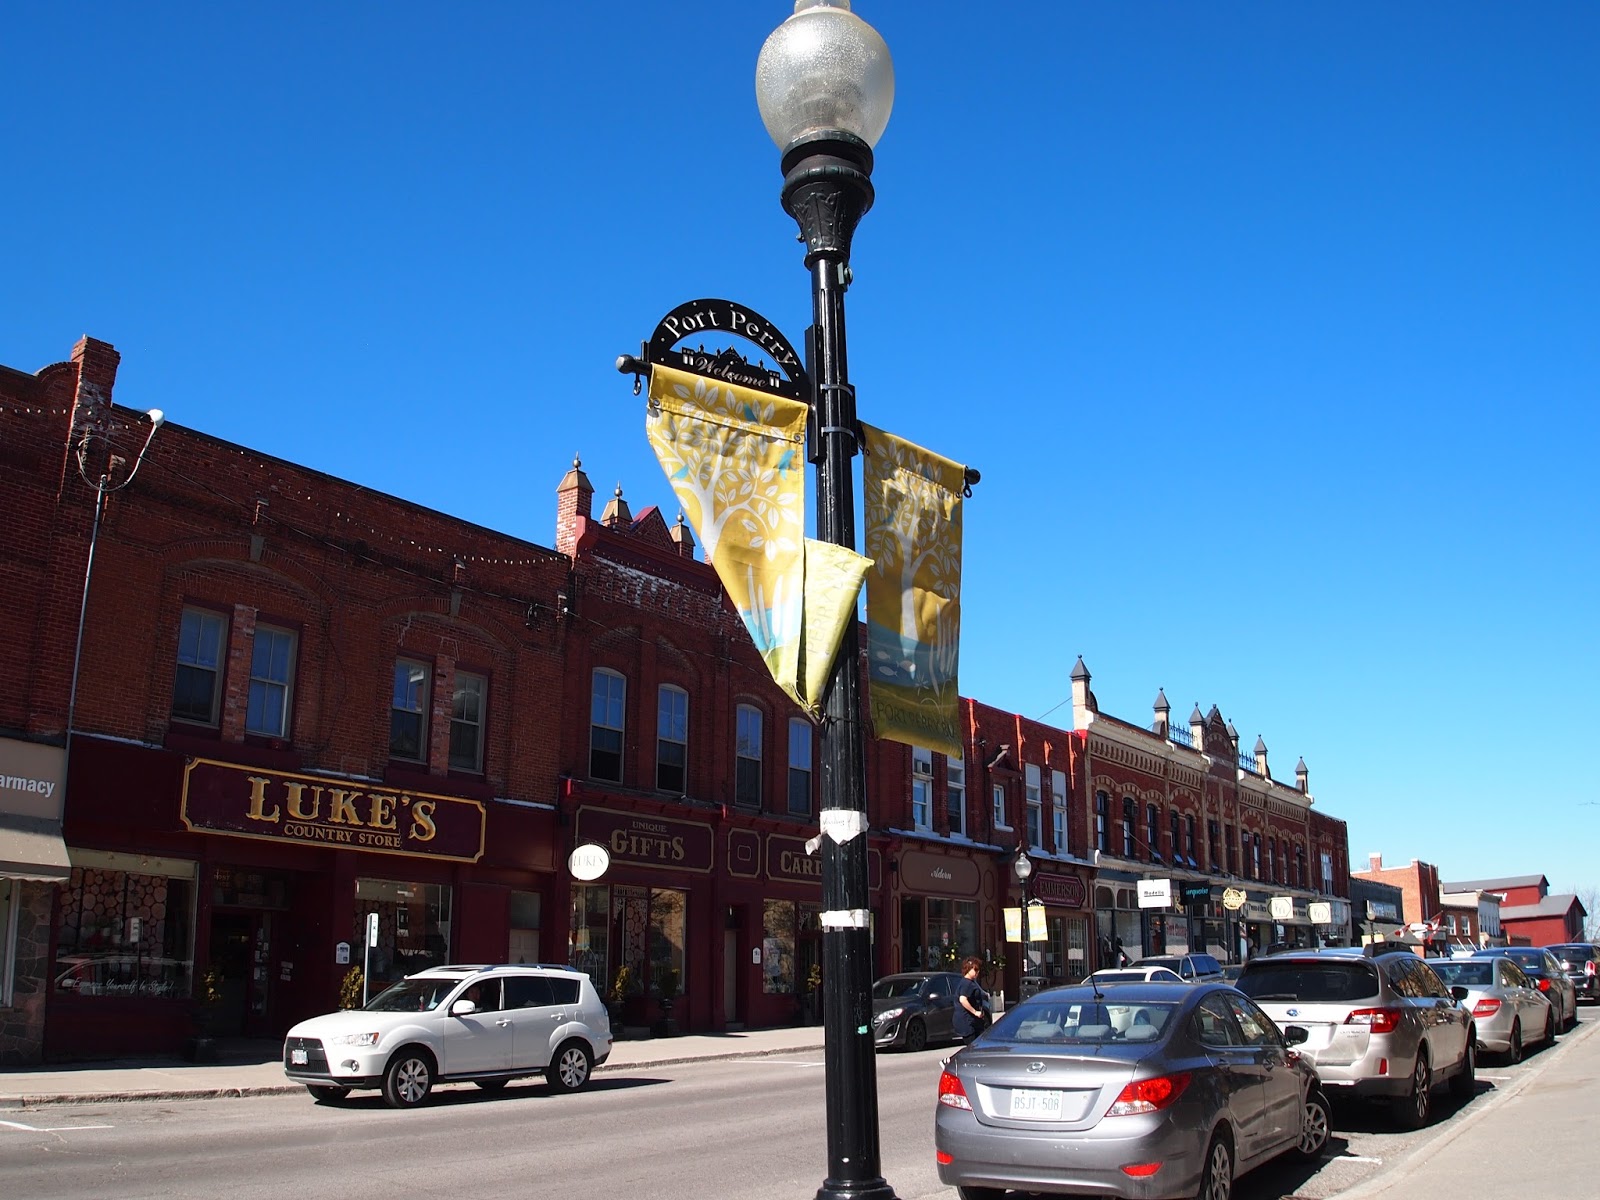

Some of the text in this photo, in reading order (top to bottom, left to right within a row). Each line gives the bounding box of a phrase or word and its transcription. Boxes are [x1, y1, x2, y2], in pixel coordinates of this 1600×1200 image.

[662, 308, 797, 367] Port Perry
[695, 355, 769, 388] Welcome
[245, 776, 437, 842] LUKE'S
[283, 824, 402, 848] COUNTRY STORE
[632, 821, 667, 833] UNIQUE
[611, 828, 685, 861] GIFTS
[1041, 881, 1080, 898] EMMERSON
